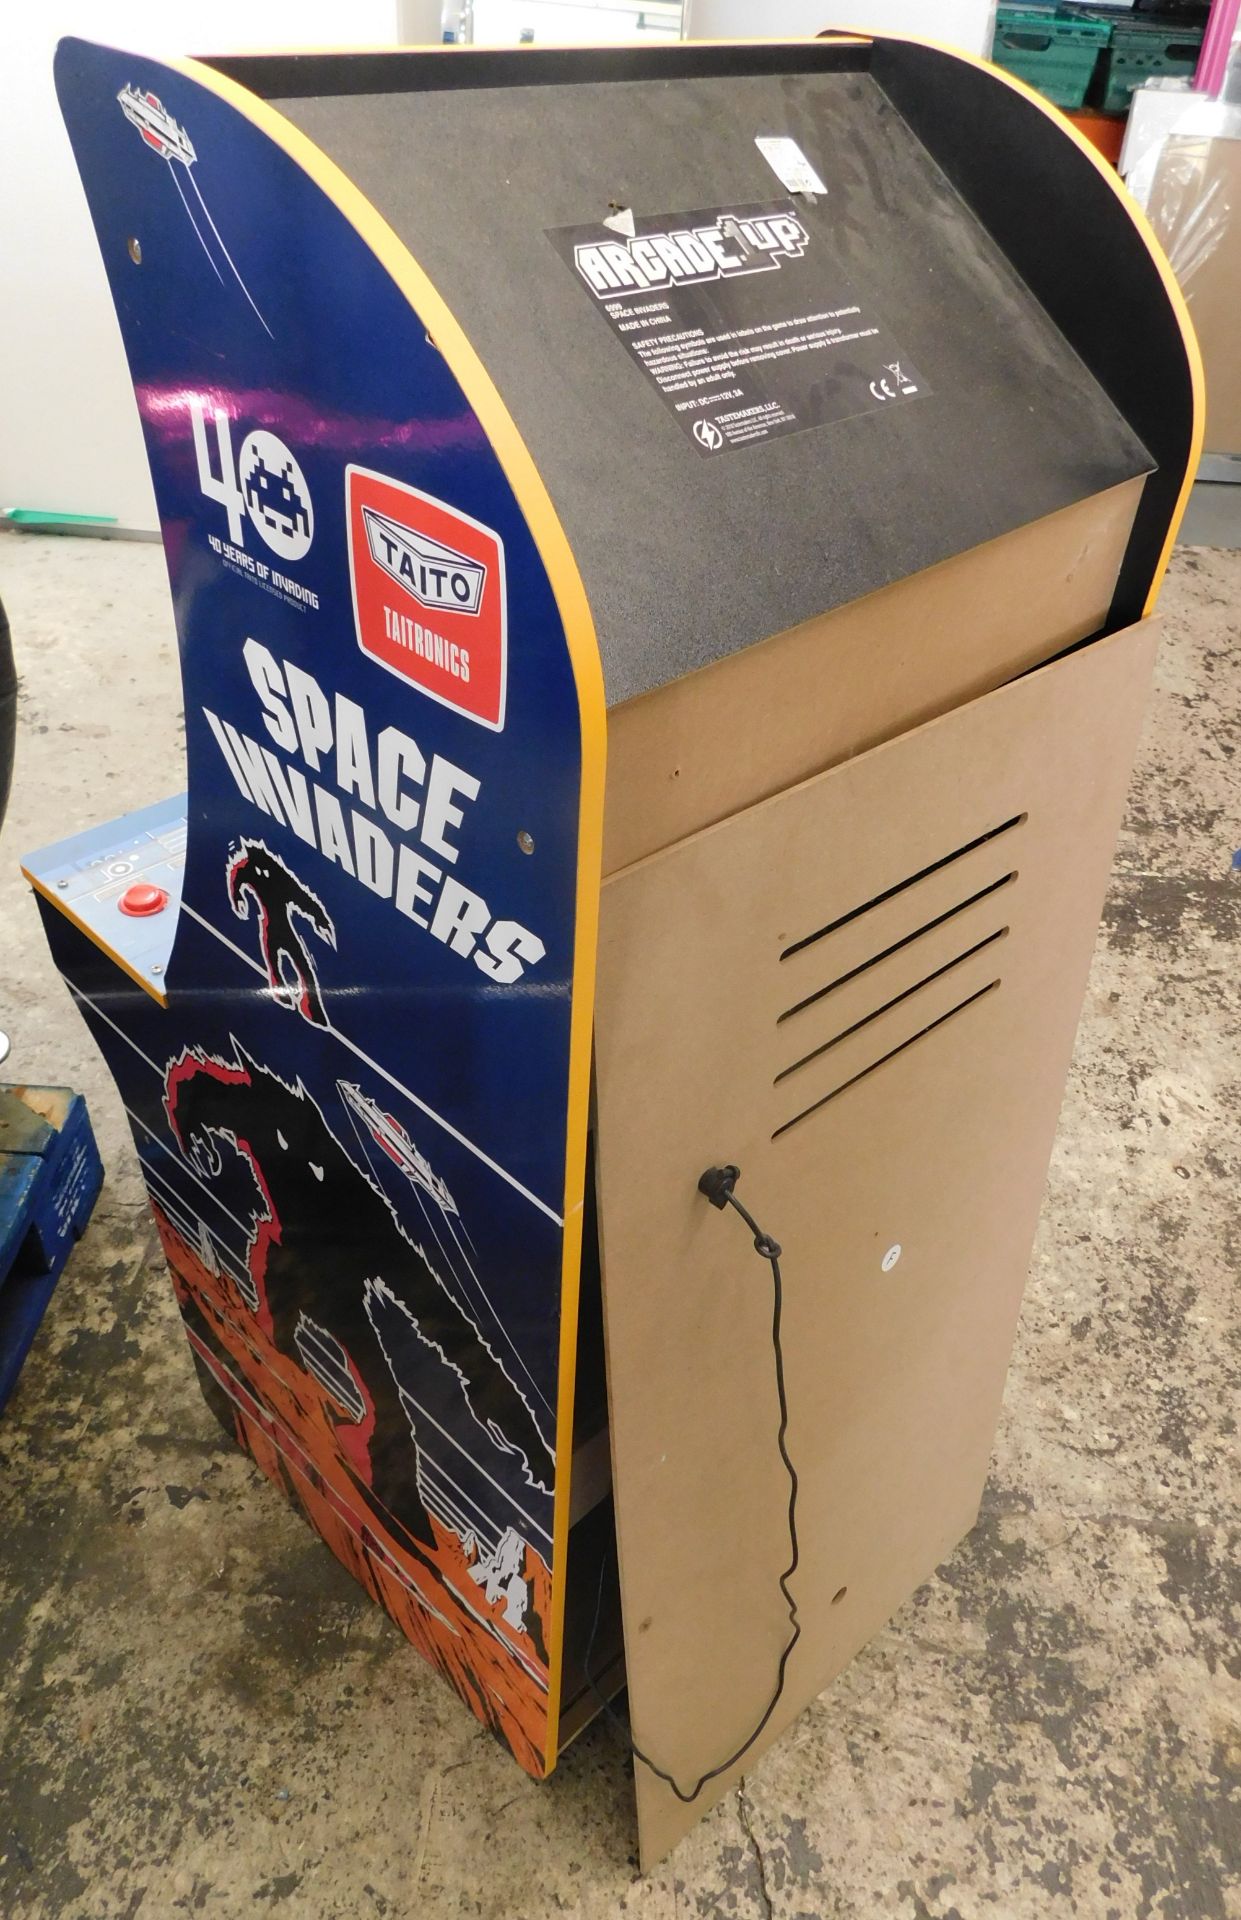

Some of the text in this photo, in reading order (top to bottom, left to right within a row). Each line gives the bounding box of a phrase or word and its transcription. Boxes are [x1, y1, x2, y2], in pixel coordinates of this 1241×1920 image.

[610, 302, 670, 319] SPACE INVADERS
[618, 315, 672, 332] MADE IN CHINA
[632, 328, 704, 350] SAFETY PRECAUTIONS
[637, 349, 652, 358] The
[651, 344, 681, 355] following
[680, 339, 706, 350] symbols
[644, 355, 678, 367] hazardous
[650, 363, 684, 375] WARNING:
[656, 371, 692, 384] Disconnect
[691, 367, 711, 377] power
[661, 380, 689, 393] handled
[674, 400, 700, 412] INPUT:
[207, 533, 319, 610] 40 YEARS OF INVADING
[379, 531, 471, 603] TAITO
[383, 605, 470, 684] TAITRONICS
[242, 637, 481, 865] SPACE
[202, 706, 546, 984] INVADERS
